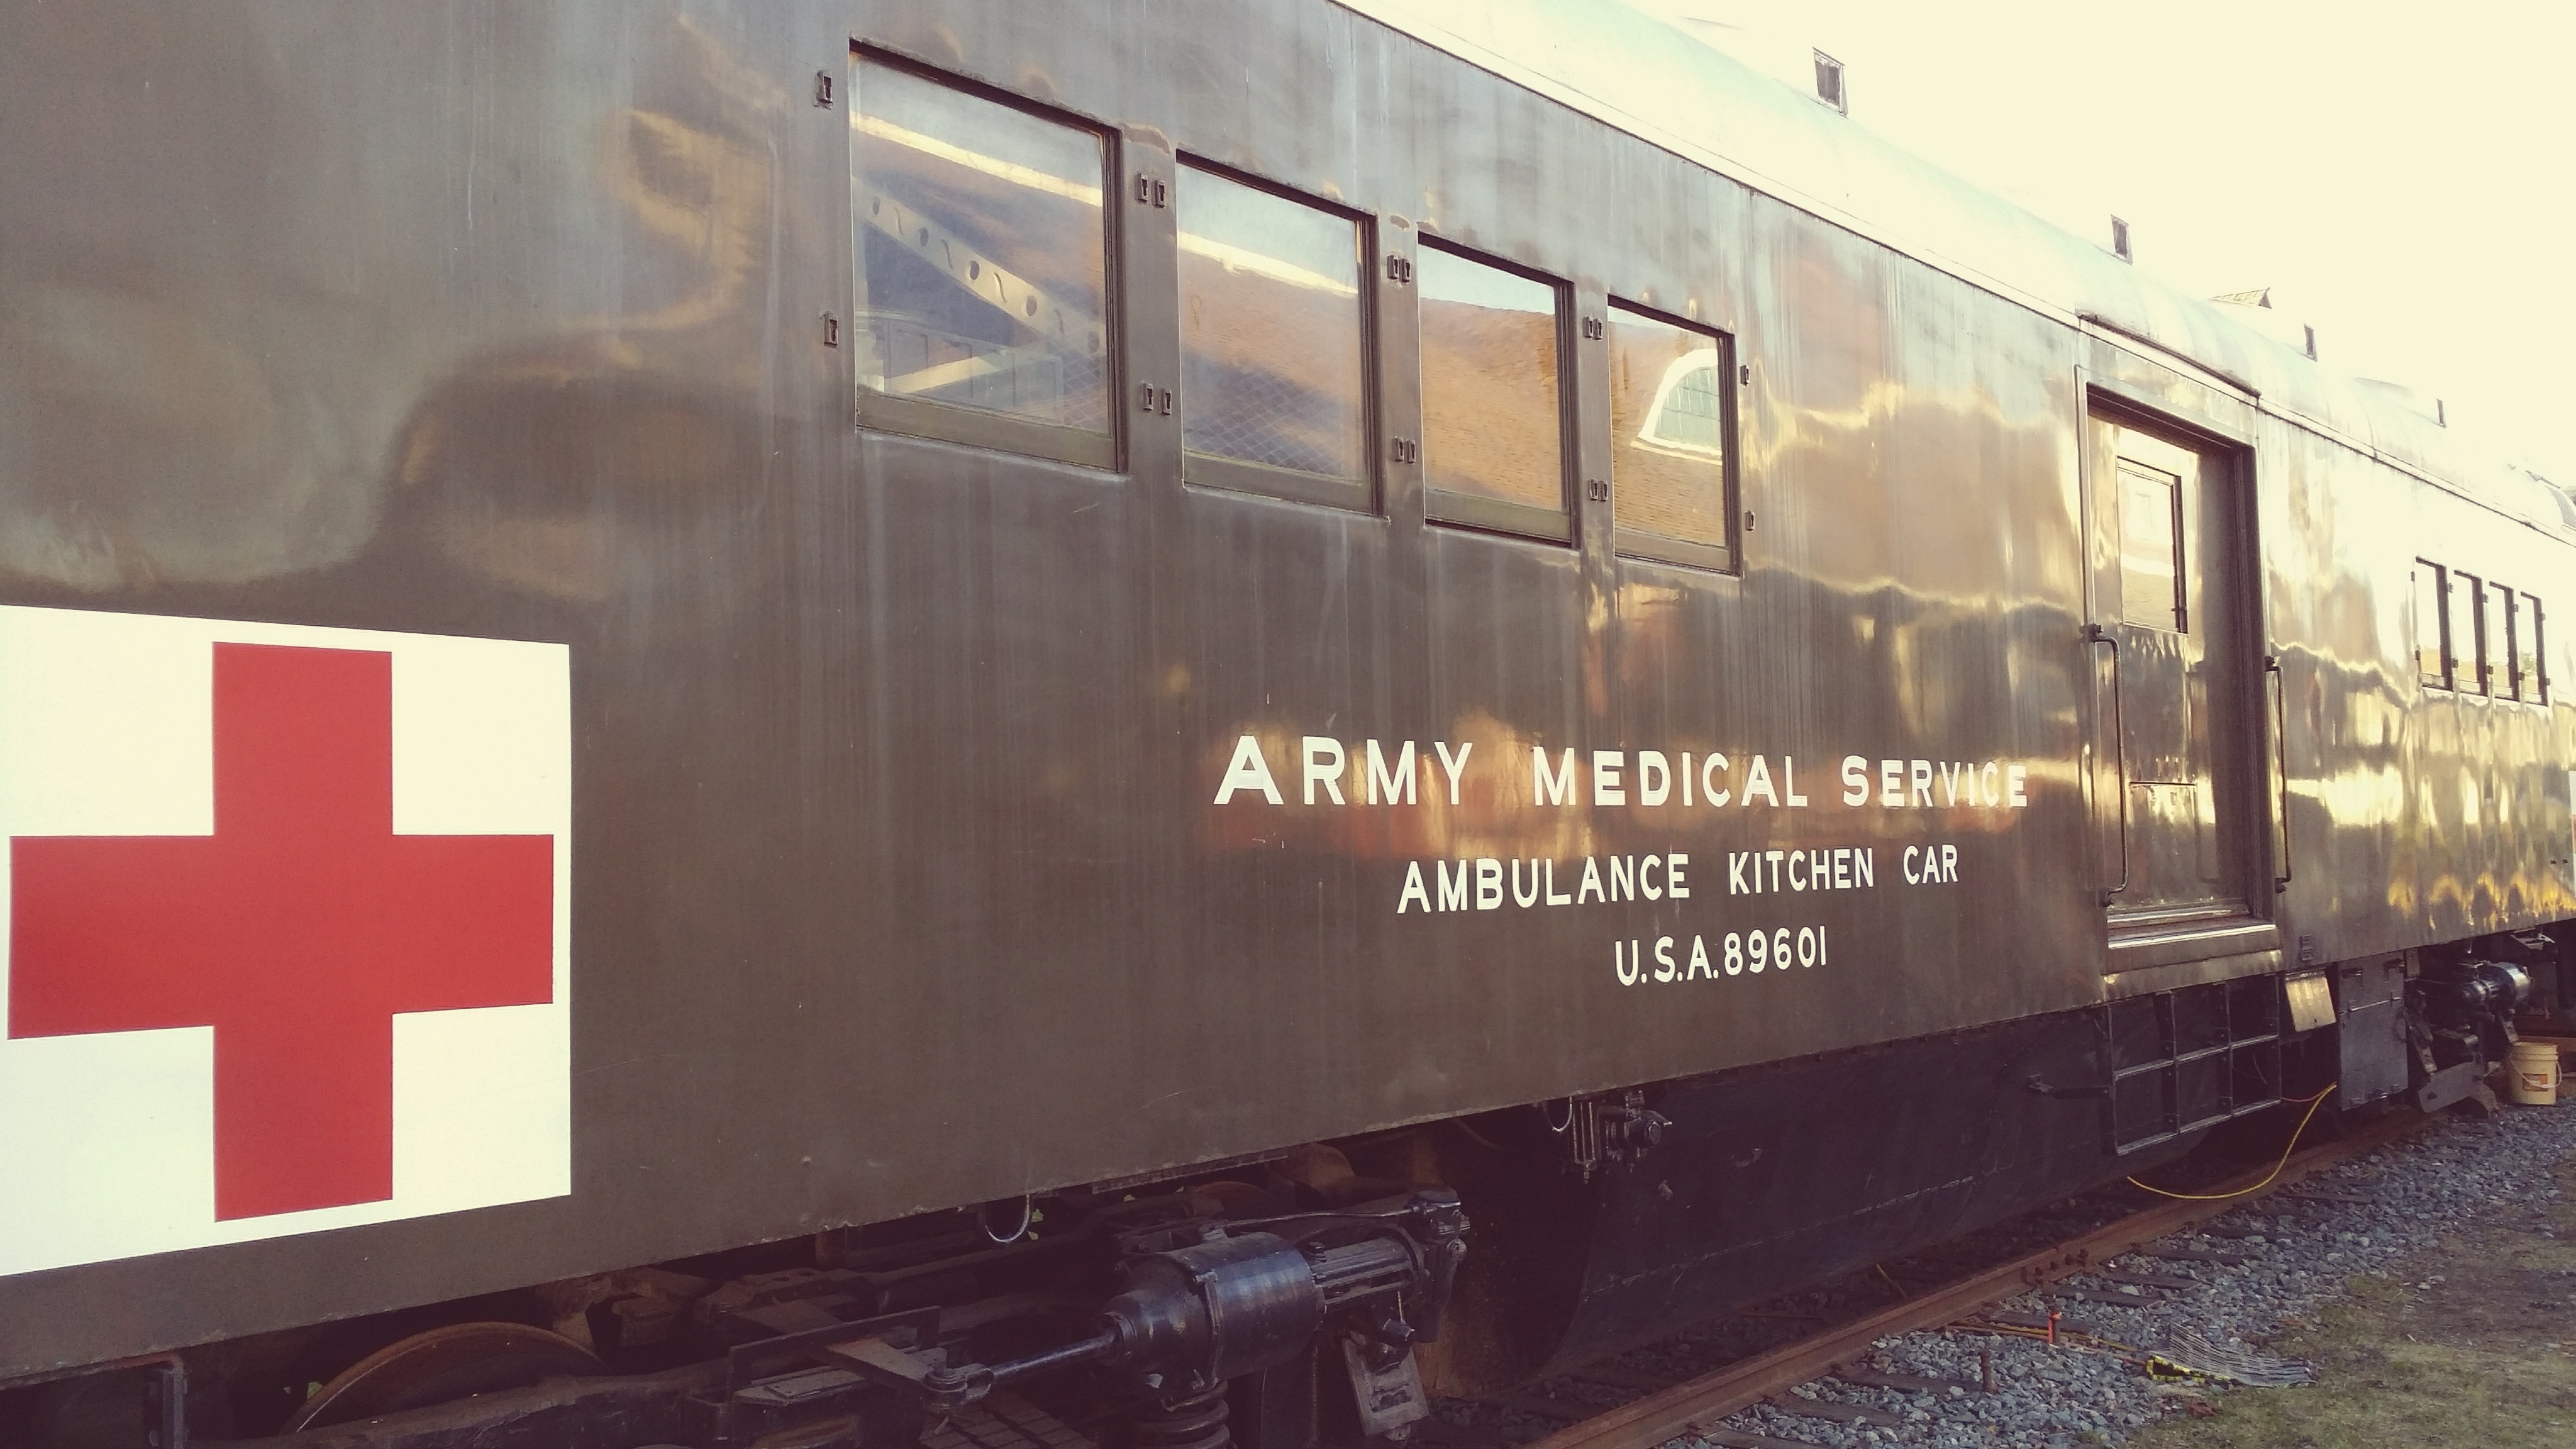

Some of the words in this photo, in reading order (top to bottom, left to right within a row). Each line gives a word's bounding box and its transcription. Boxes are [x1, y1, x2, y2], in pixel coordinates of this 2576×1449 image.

[1213, 735, 1473, 806] ARMY
[1533, 746, 1808, 808] MEDICAL
[1841, 755, 2028, 808] SERVICE
[1396, 853, 1690, 914] AMBULANCE
[1728, 848, 1875, 894] KITCHEN
[1903, 845, 1959, 884] CAR
